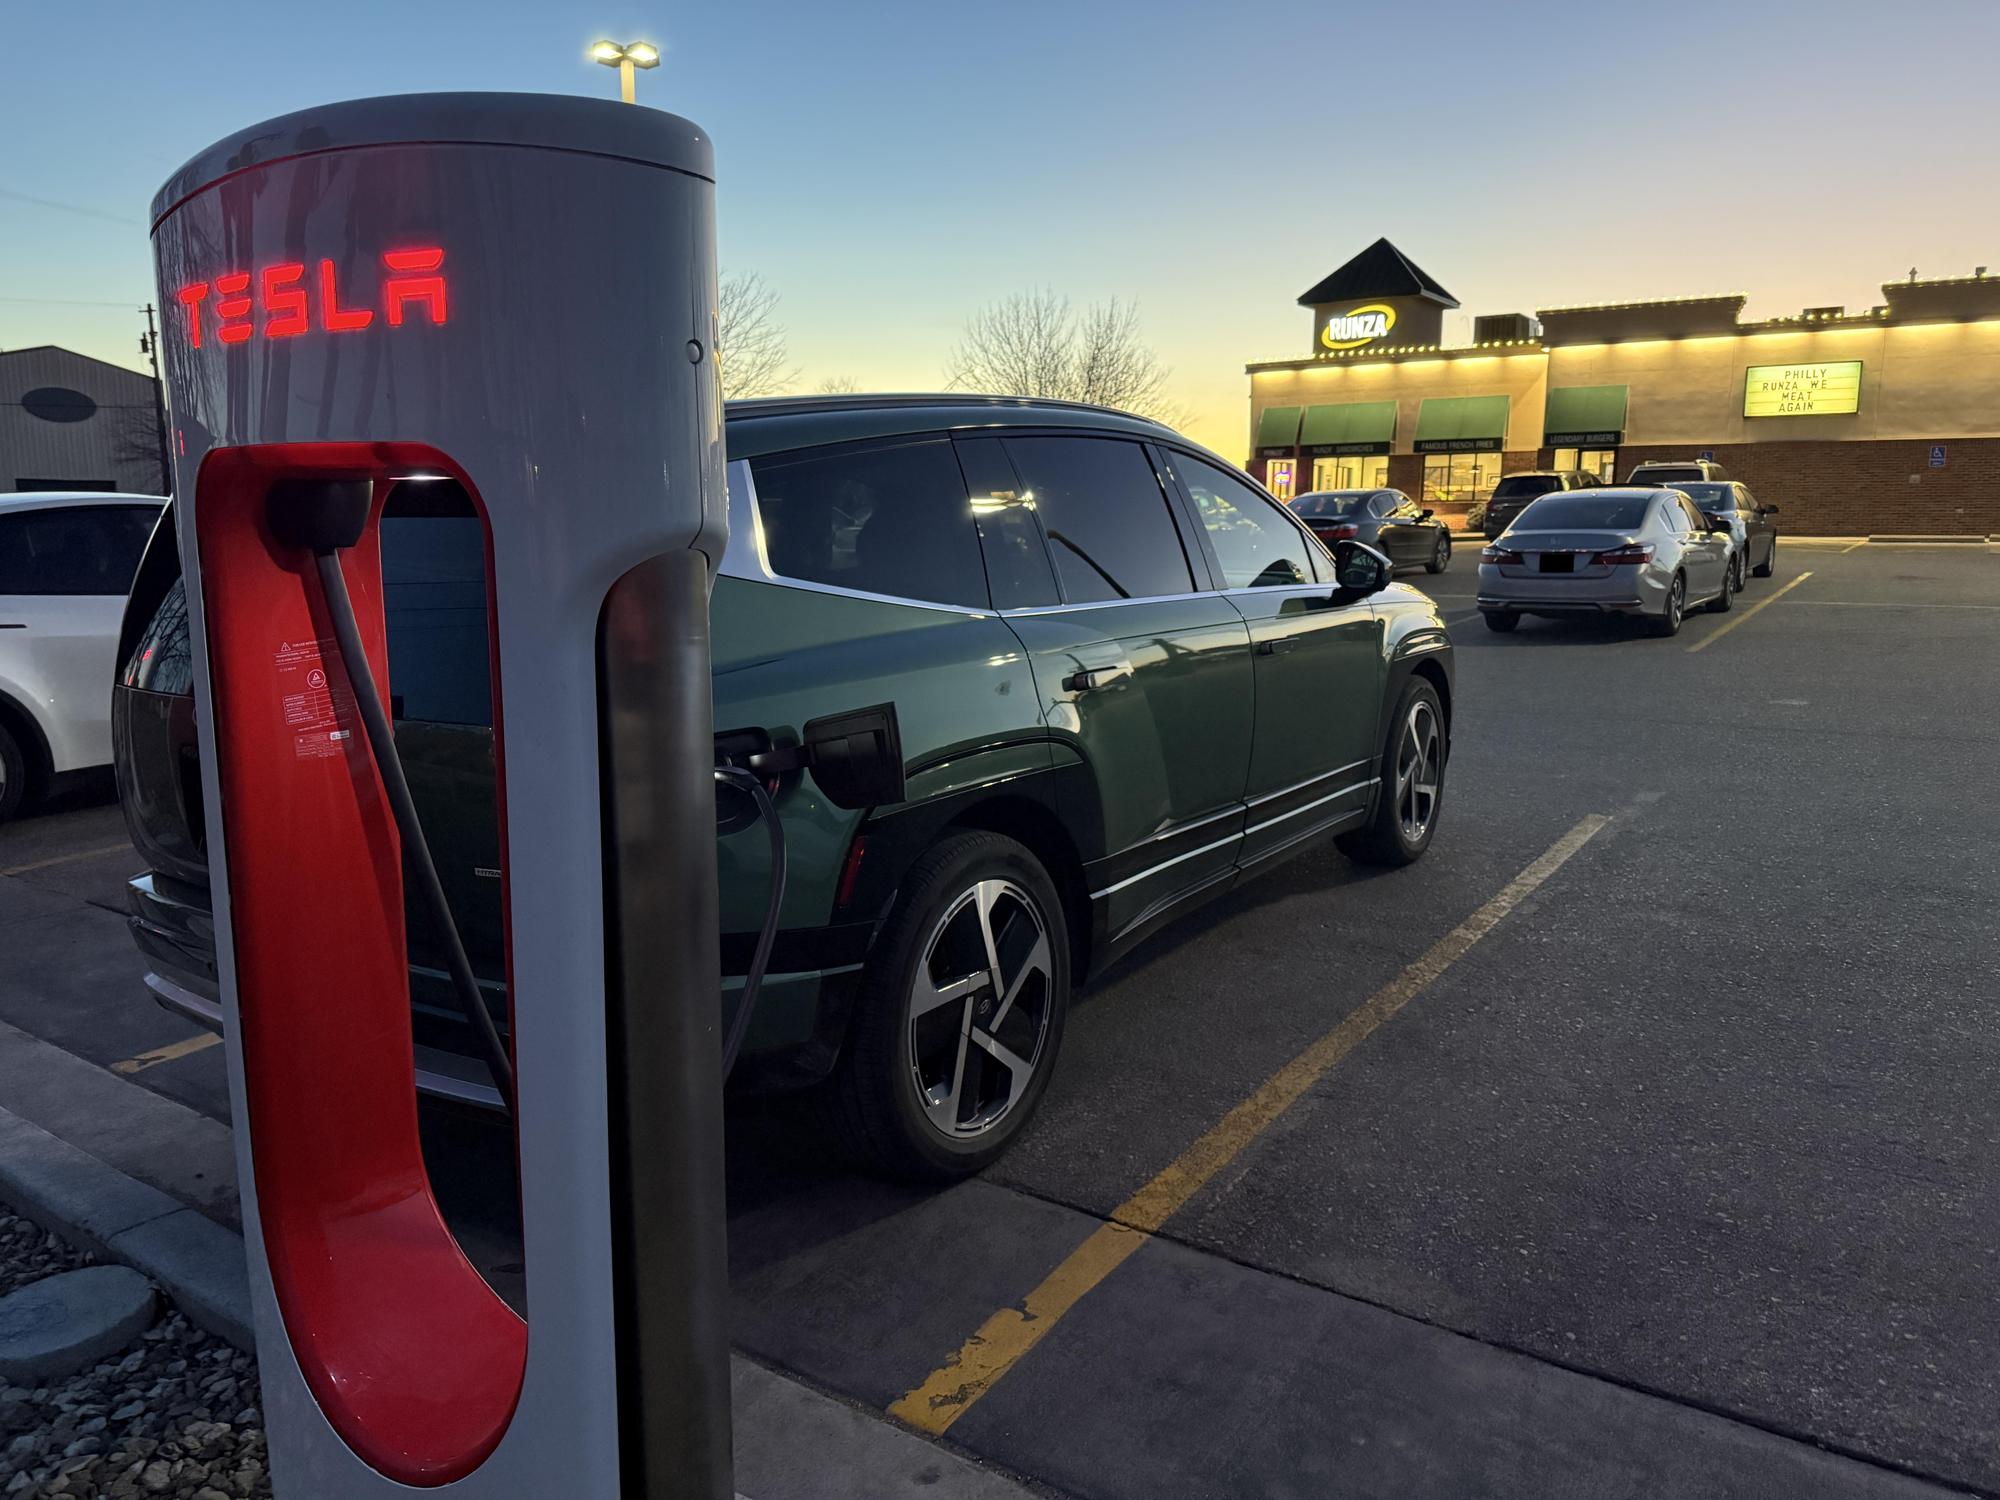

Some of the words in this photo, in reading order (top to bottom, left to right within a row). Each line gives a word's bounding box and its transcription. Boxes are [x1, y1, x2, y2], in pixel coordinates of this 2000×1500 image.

[179, 247, 447, 349] TESLA
[1329, 314, 1388, 341] RUNZA
[1784, 369, 1828, 380] PHILLY
[1762, 381, 1799, 392] RUNZA
[1810, 380, 1828, 390] WE
[1781, 391, 1813, 401] MEAT
[1779, 402, 1814, 413] AGAIN
